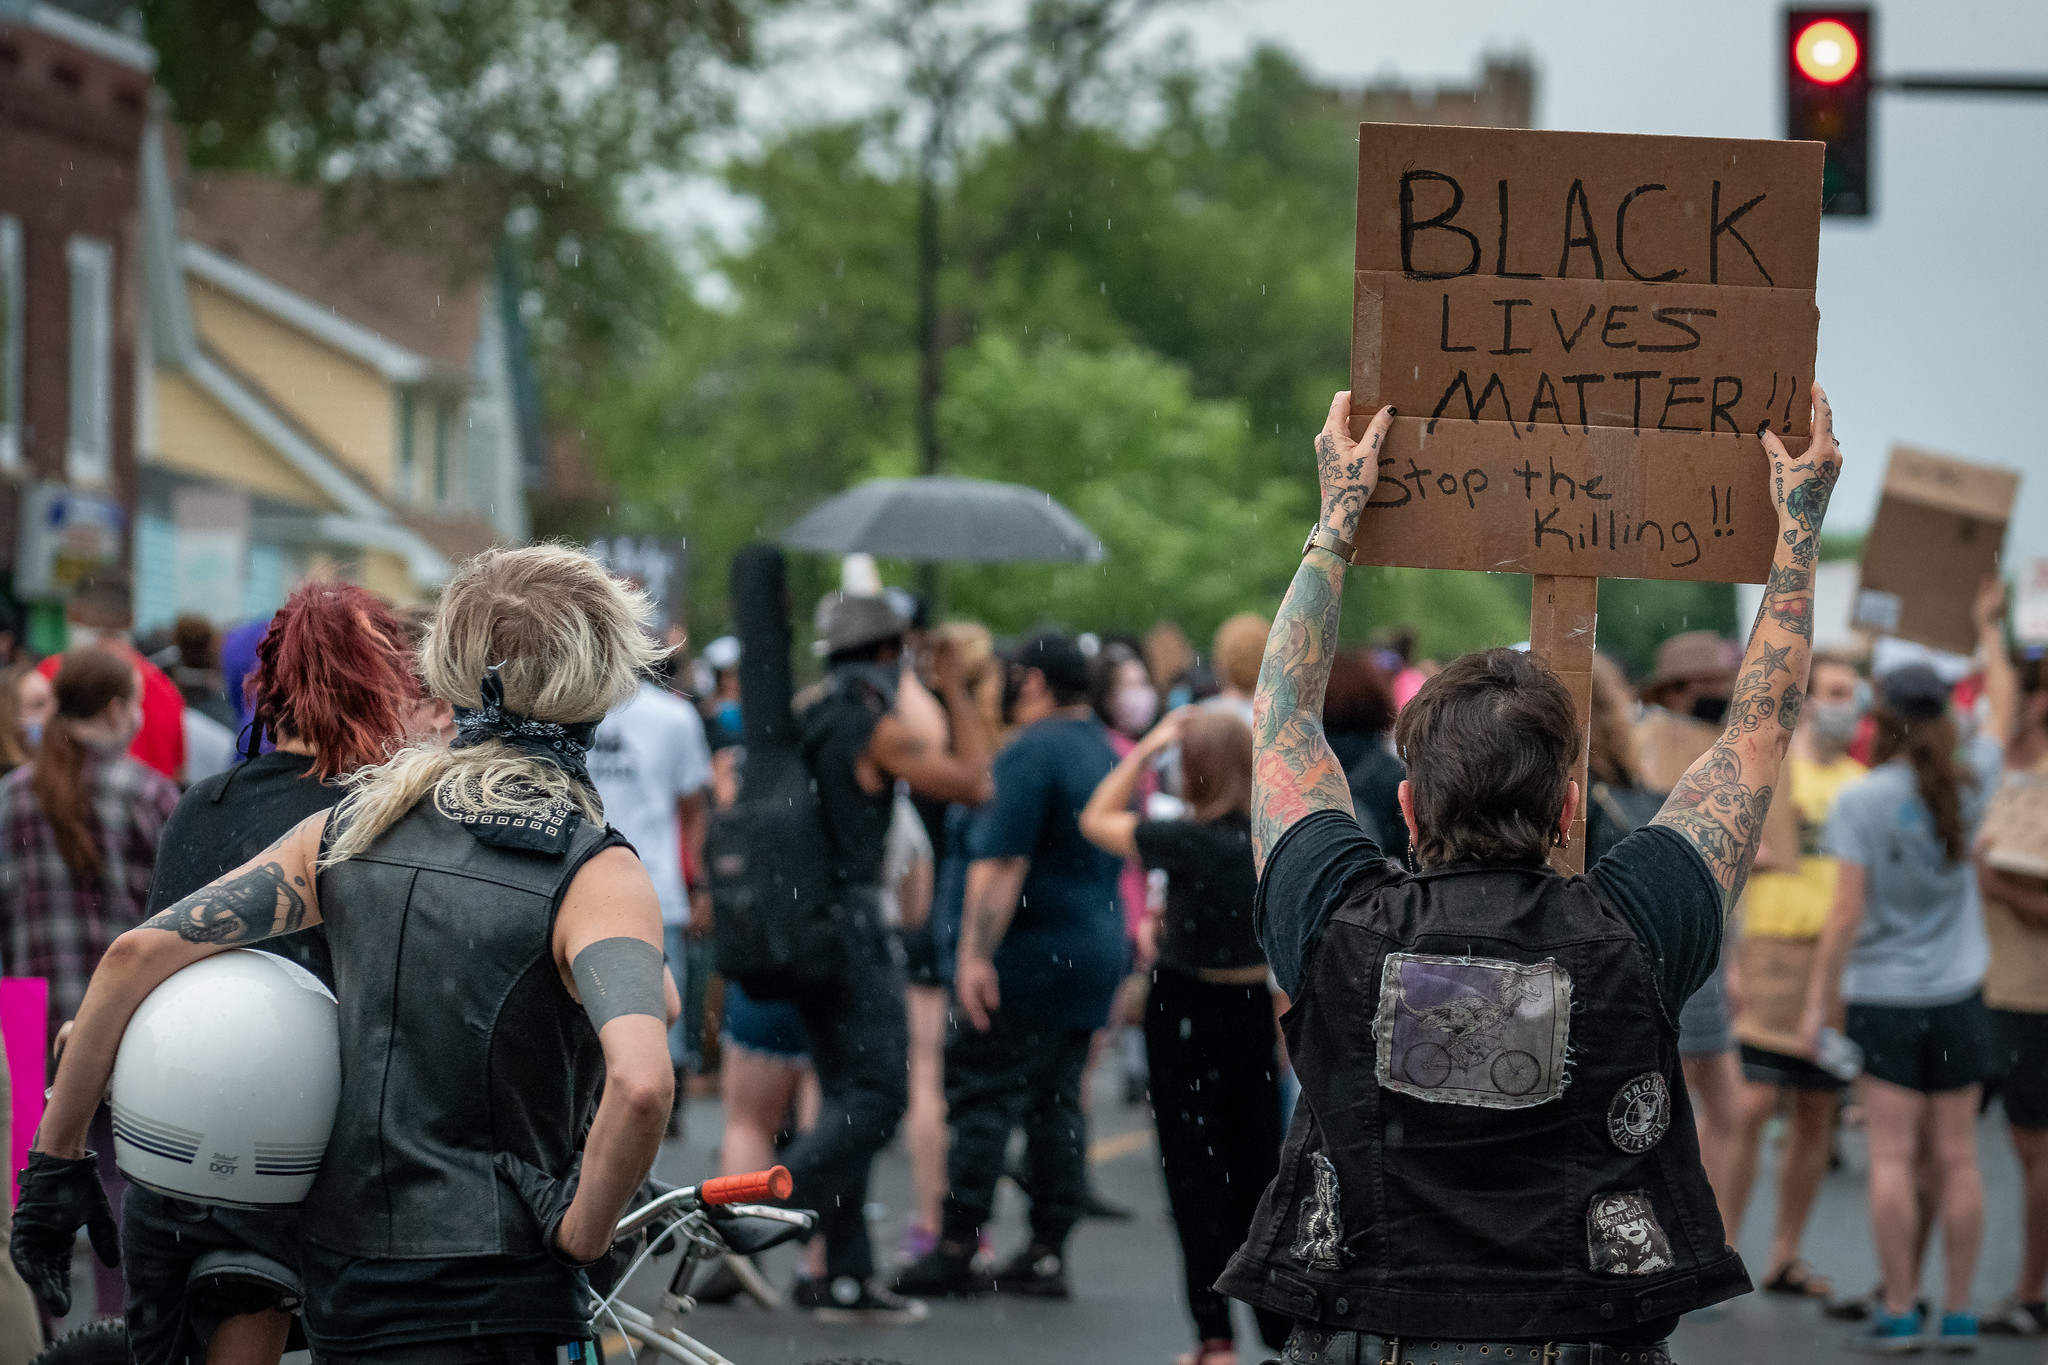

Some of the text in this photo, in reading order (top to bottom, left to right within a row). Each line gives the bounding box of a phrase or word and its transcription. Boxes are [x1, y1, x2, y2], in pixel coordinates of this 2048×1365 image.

[1400, 167, 1775, 286] BLACK
[1440, 294, 1717, 355] LIVES
[1364, 456, 1612, 509] Stop the
[1775, 461, 1784, 475] do
[209, 1163, 238, 1175] DOT
